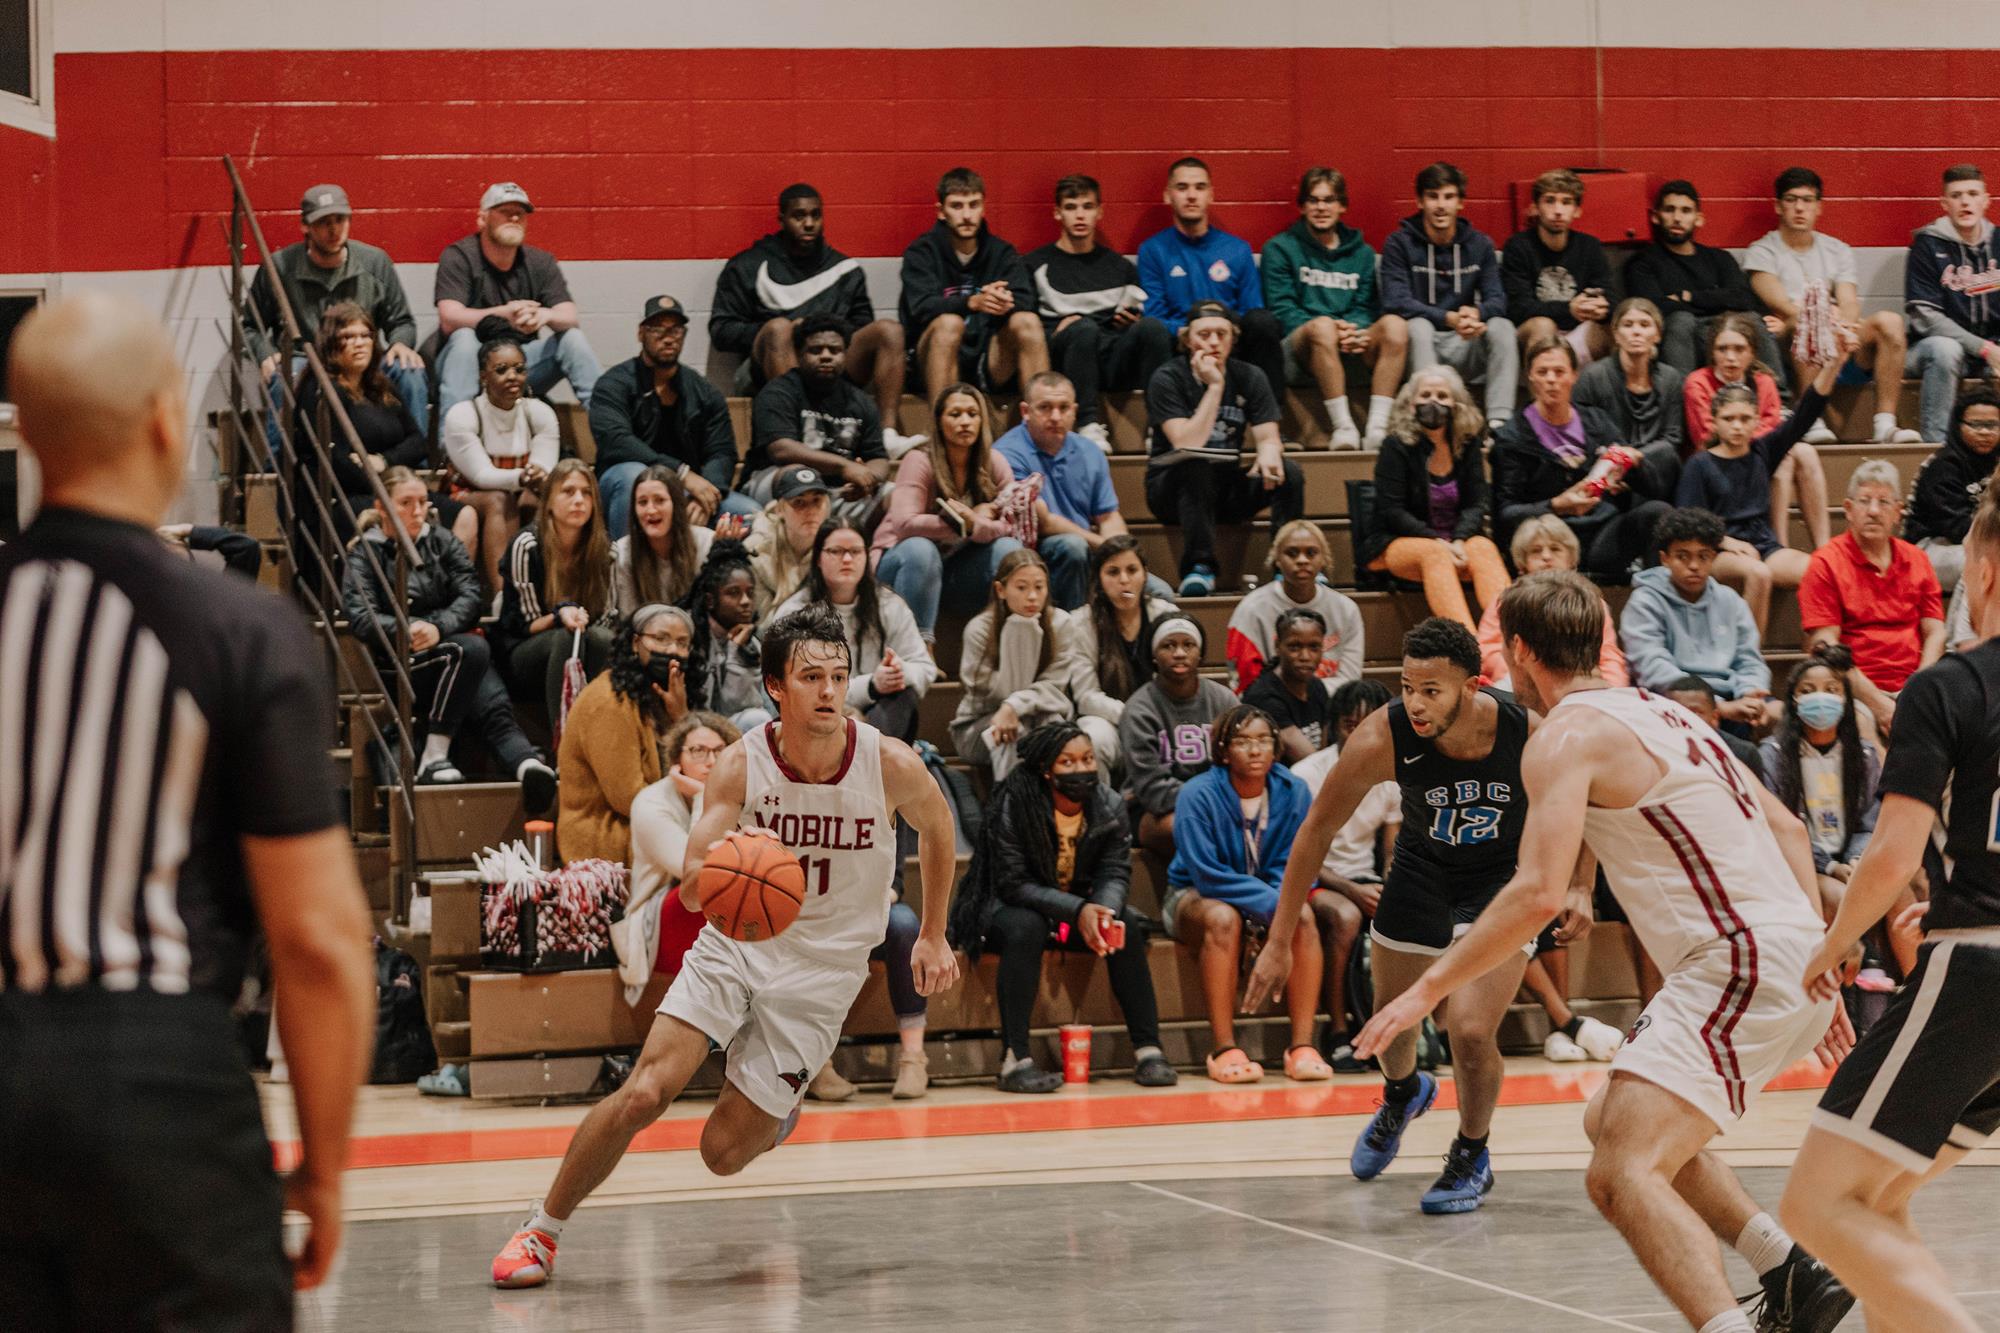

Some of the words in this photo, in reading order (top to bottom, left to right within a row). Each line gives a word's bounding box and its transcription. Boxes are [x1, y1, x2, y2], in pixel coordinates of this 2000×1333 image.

[1425, 780, 1510, 806] SBC
[755, 811, 875, 850] MOBILE
[1429, 806, 1503, 846] 12
